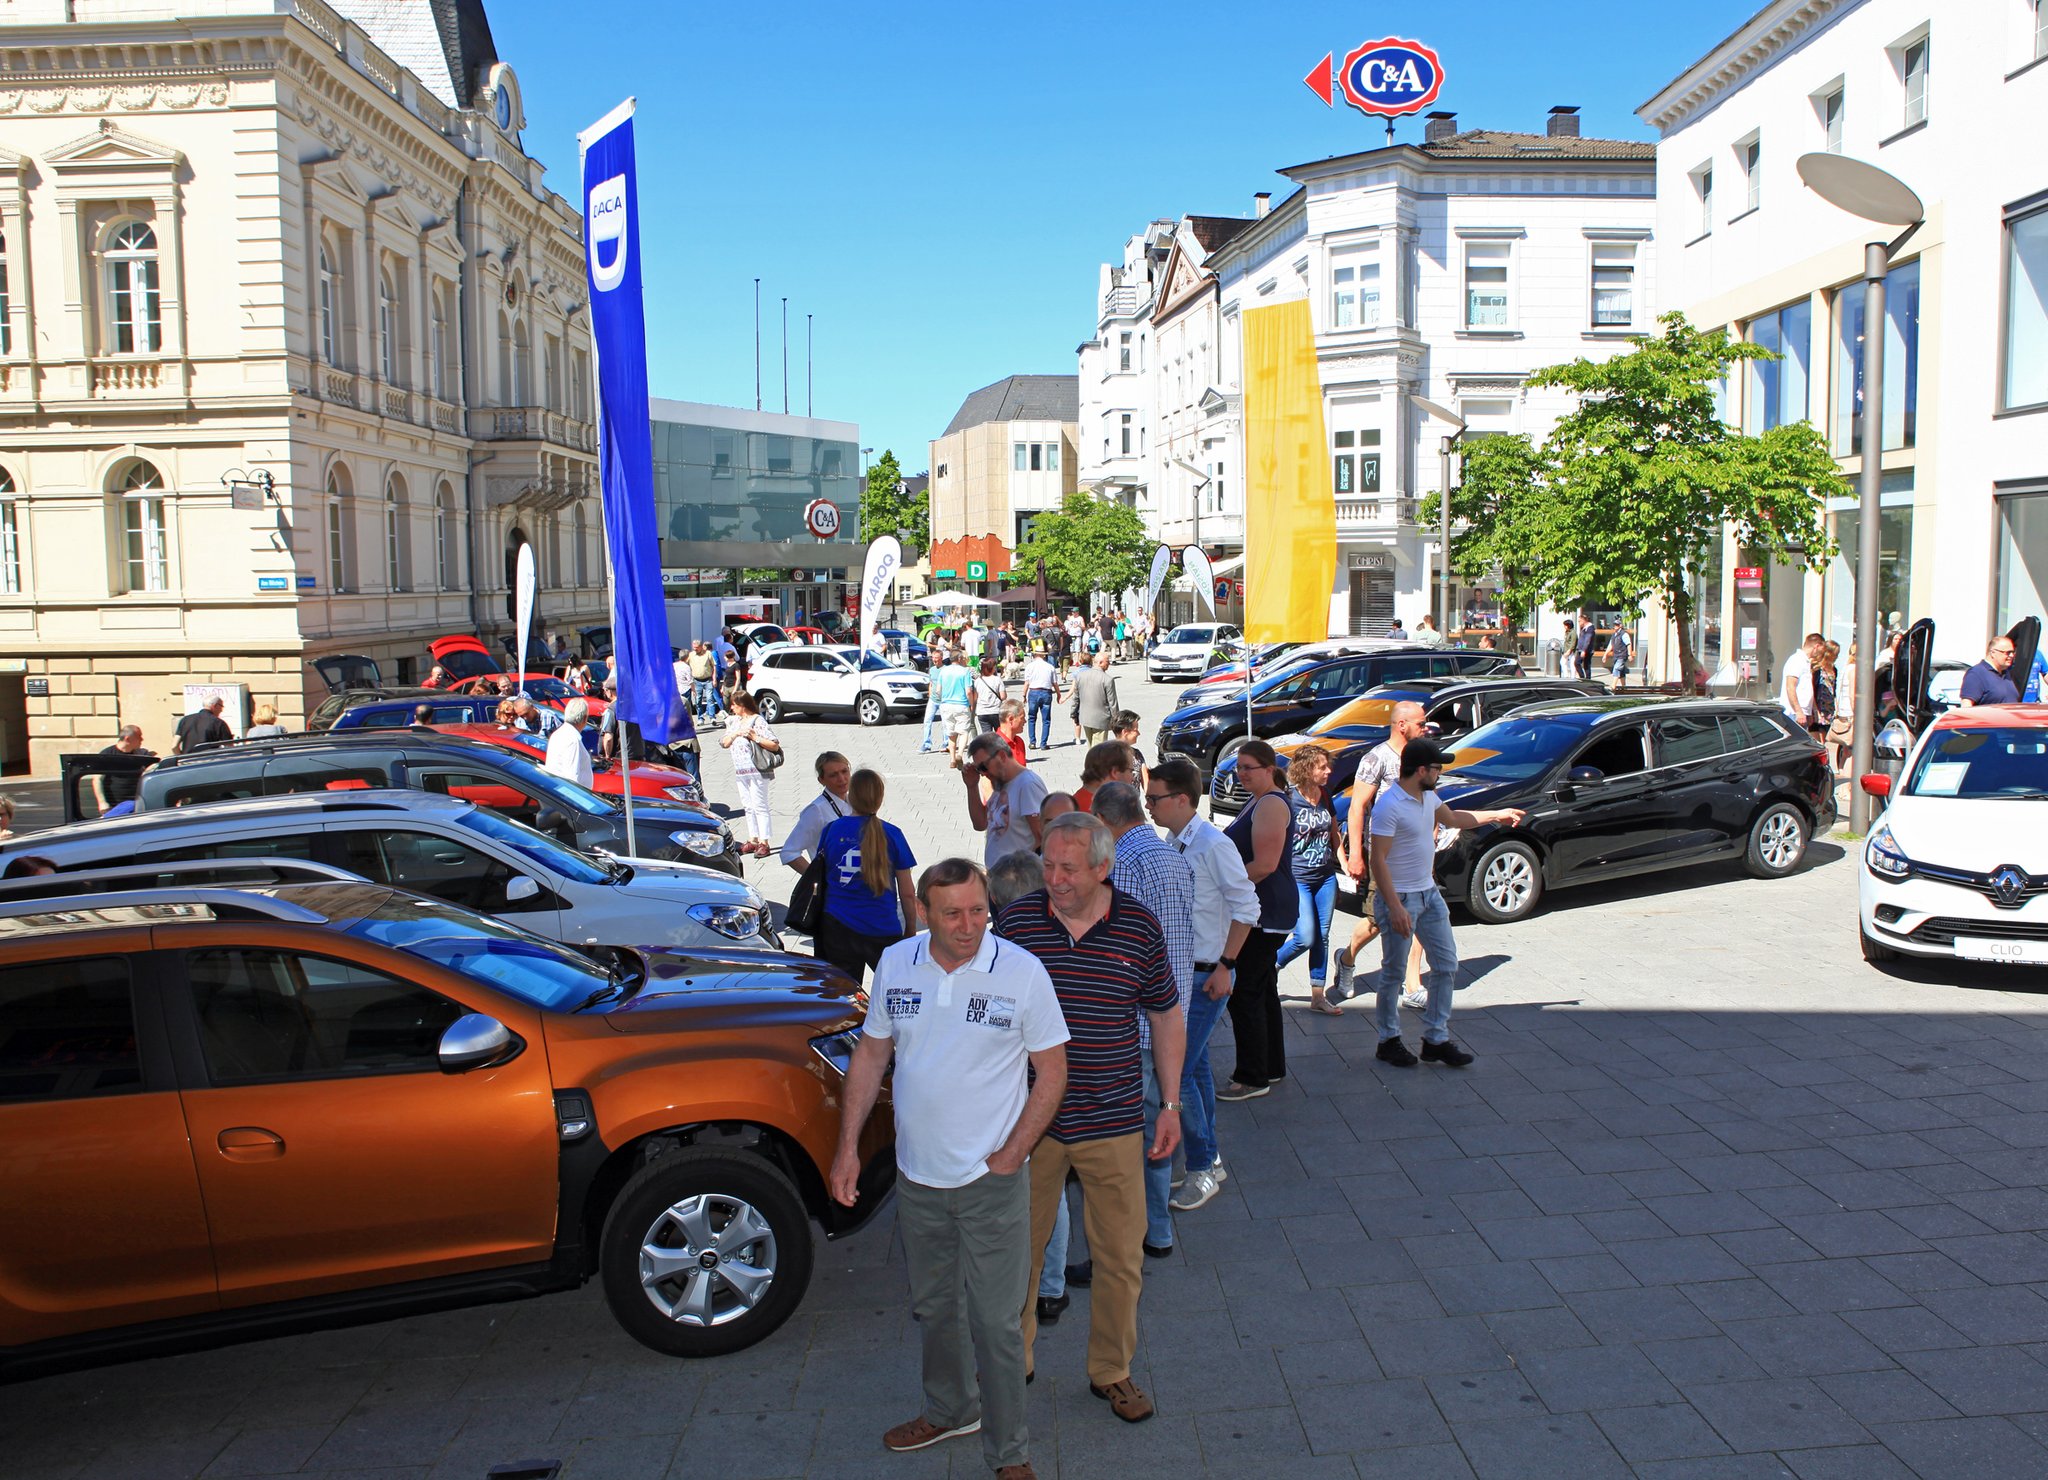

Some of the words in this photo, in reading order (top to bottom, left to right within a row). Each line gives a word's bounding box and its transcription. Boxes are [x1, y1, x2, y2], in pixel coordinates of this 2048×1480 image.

[1360, 59, 1425, 93] C&A
[593, 195, 622, 218] ACA
[815, 509, 835, 528] C&A
[1356, 557, 1385, 567] CHRIST
[970, 564, 983, 577] D
[864, 553, 895, 611] KAROQ
[1990, 944, 2023, 956] CLIO
[968, 997, 989, 1012] ADV.
[966, 1010, 987, 1024] EXP.
